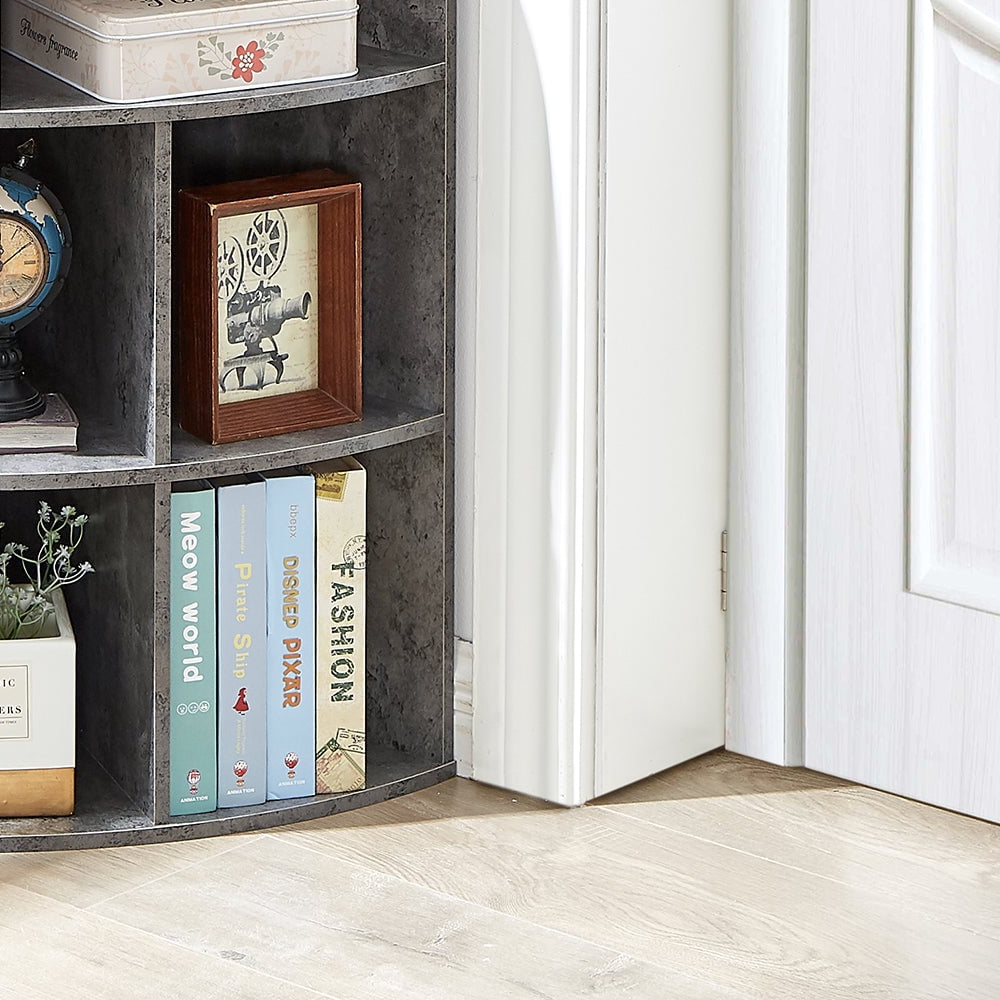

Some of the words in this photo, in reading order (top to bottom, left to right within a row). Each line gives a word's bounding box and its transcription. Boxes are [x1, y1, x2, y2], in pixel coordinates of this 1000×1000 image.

[20, 17, 47, 46] Flowers
[45, 34, 79, 61] fragrance
[180, 511, 202, 591] Meow
[234, 562, 252, 622] Pirate
[282, 556, 299, 628] DISNEP
[182, 602, 204, 682] world
[233, 633, 252, 679] Ship
[331, 561, 354, 702] FASHION
[282, 638, 302, 708] PIXAR
[180, 795, 208, 803] ANIMATION
